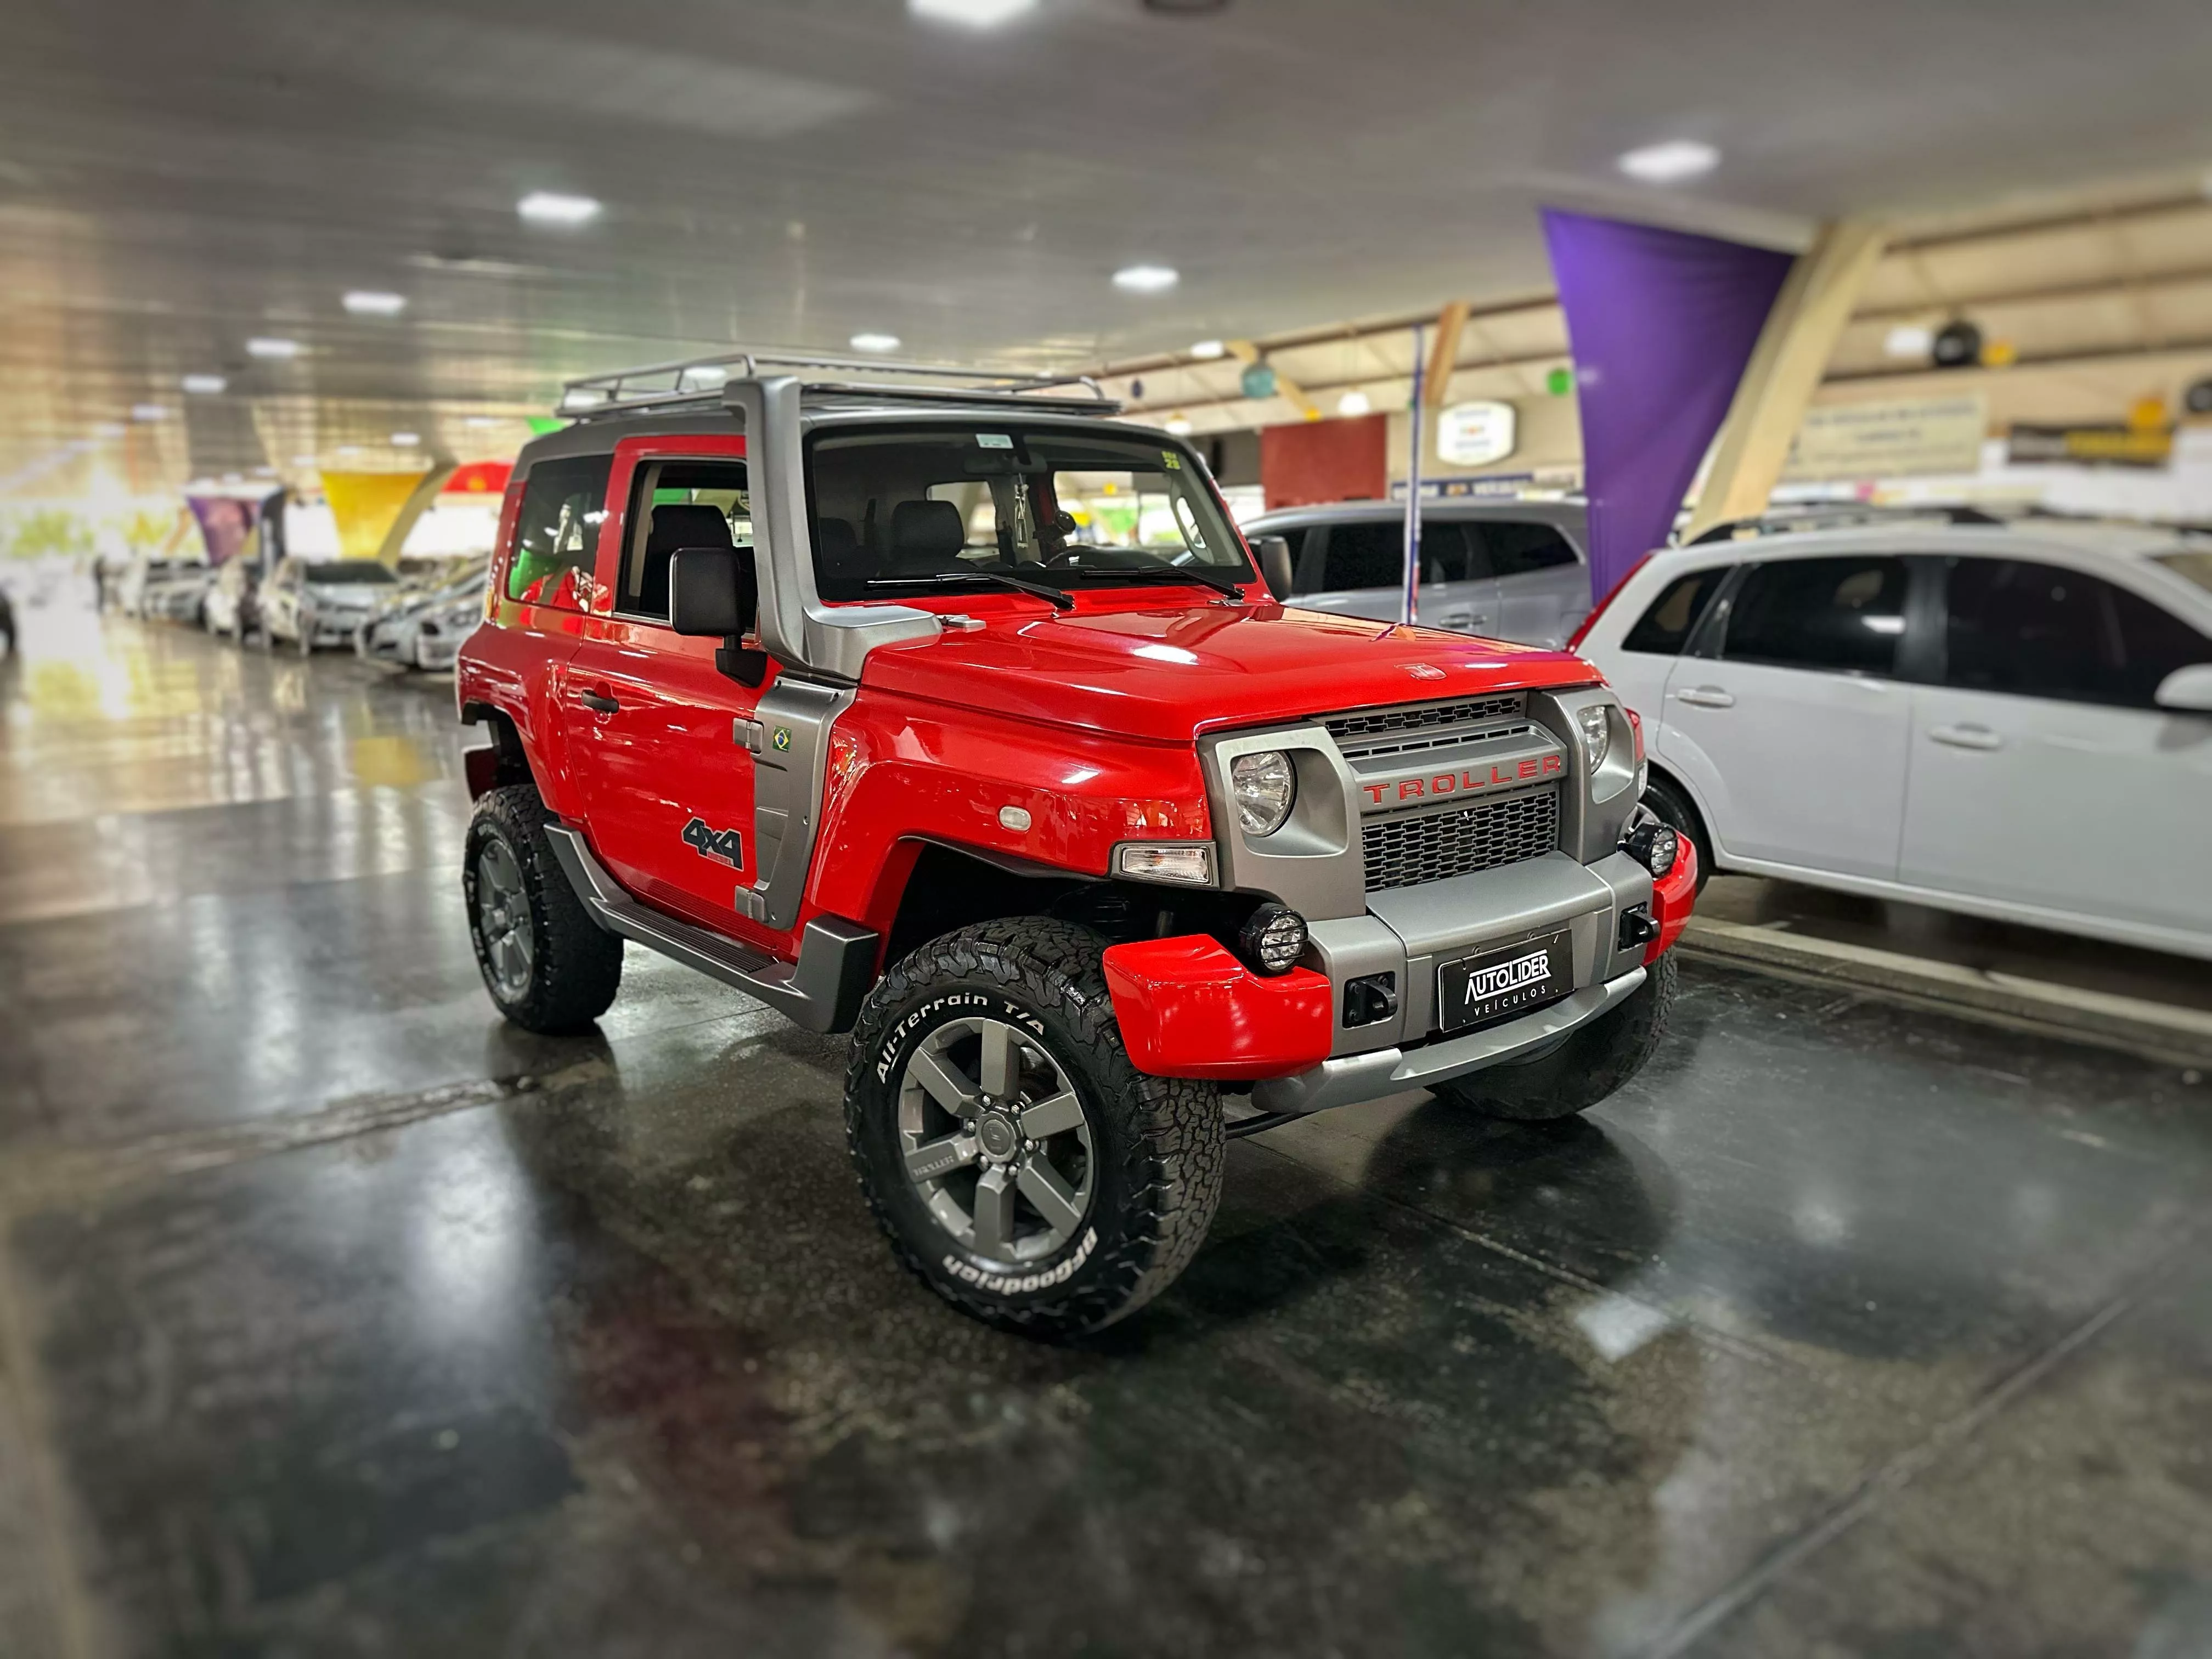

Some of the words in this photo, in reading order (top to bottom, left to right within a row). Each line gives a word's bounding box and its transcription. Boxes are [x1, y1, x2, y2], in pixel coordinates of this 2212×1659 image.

[1364, 755, 1561, 804] TROLLER
[1465, 950, 1551, 1005] AUTOLIDER
[877, 992, 988, 1084] All-Terrain
[1004, 1001, 1044, 1035] T/A
